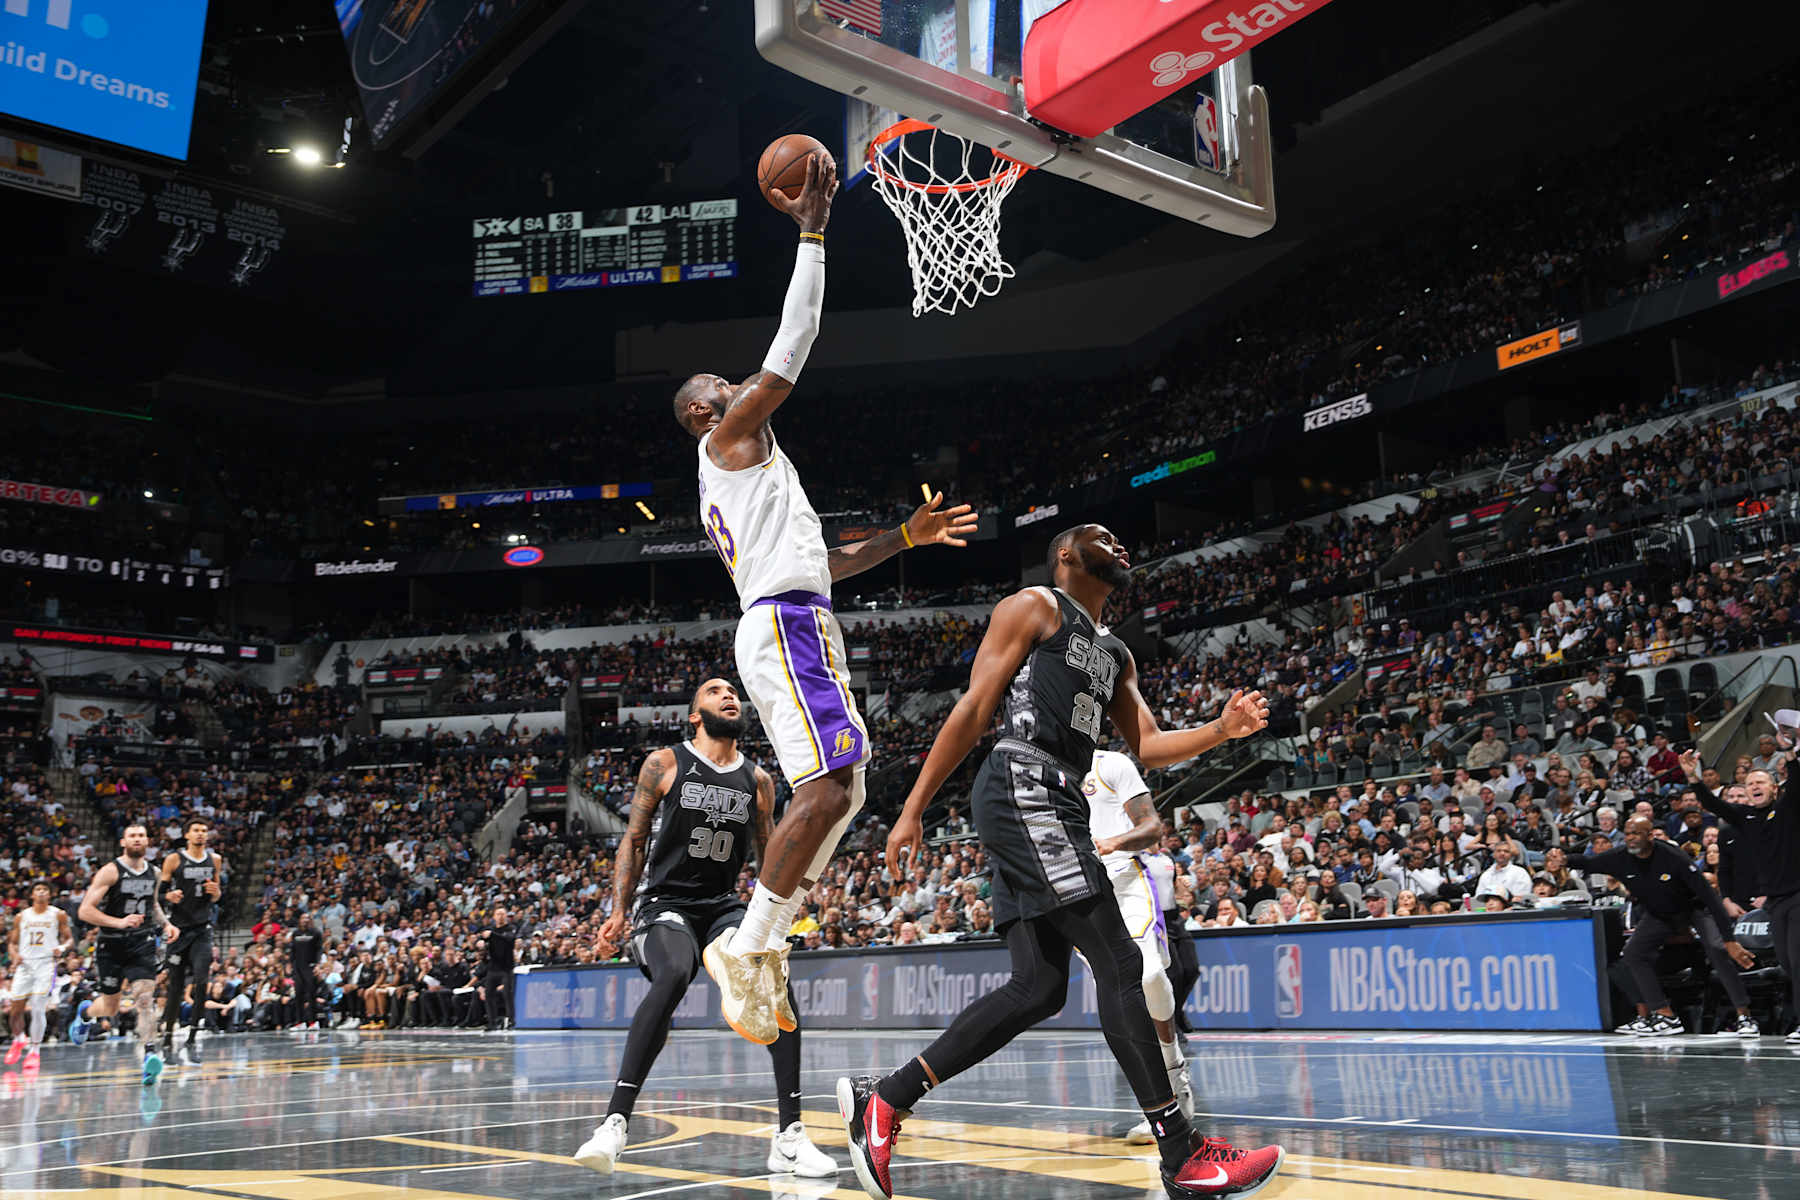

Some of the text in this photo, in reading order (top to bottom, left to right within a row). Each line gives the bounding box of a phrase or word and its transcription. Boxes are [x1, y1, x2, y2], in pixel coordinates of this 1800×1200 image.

[0, 41, 46, 73] ild
[81, 191, 142, 214] 2007
[634, 207, 653, 223] 42
[661, 205, 690, 220] LAL
[157, 211, 217, 233] 2013
[524, 214, 573, 231] SA 38
[227, 228, 281, 251] 2014
[609, 270, 655, 284] ULTRA
[1508, 336, 1554, 359] HOLT
[532, 489, 574, 502] ULTRA
[0, 548, 41, 567] G%
[74, 556, 104, 573] TO
[314, 558, 399, 577] Bitdefender
[679, 781, 753, 825] SATX
[688, 826, 735, 863] 30
[29, 930, 45, 947] 12
[1330, 945, 1559, 1012] NBAStore.com
